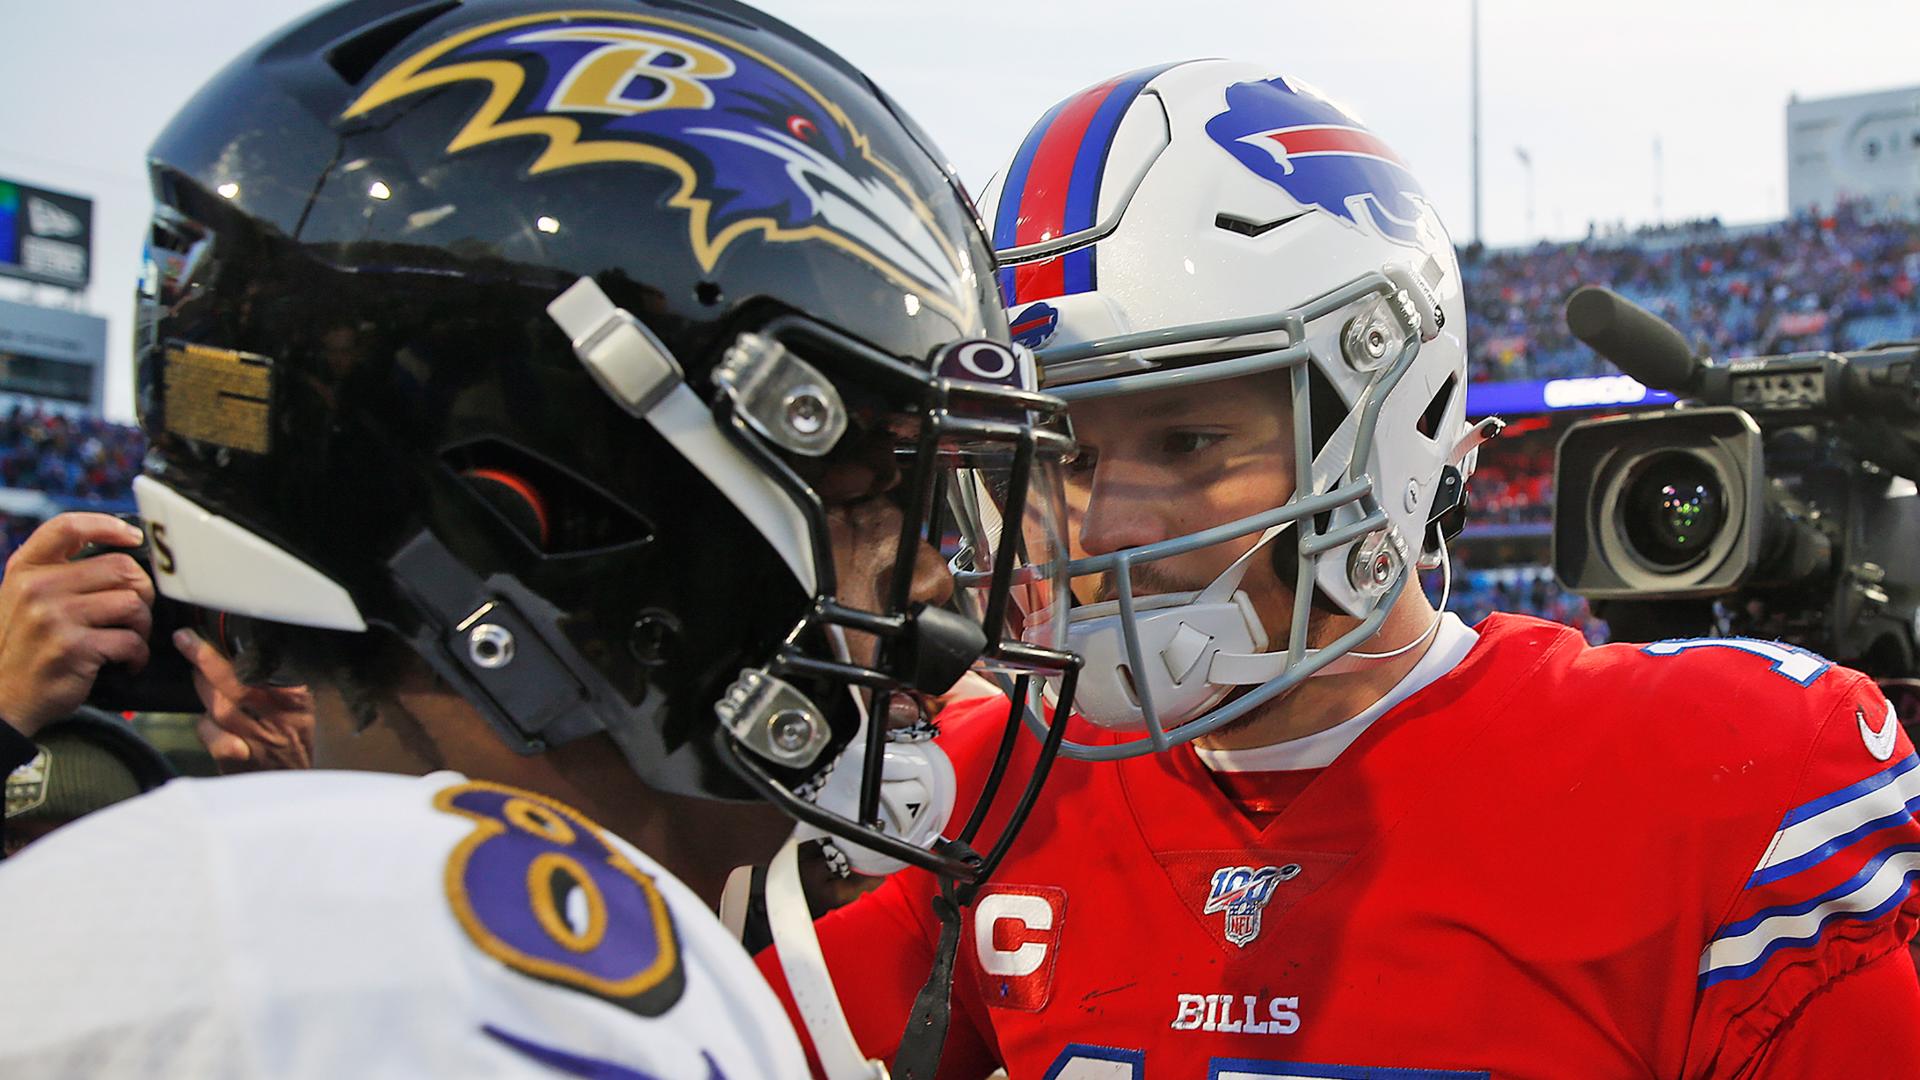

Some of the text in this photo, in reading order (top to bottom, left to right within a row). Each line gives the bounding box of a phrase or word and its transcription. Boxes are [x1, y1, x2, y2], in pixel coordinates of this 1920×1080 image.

[506, 26, 737, 116] B
[431, 779, 687, 1019] 8
[974, 893, 1054, 976] C
[1231, 915, 1252, 935] NFL
[1171, 993, 1301, 1035] BILLS
